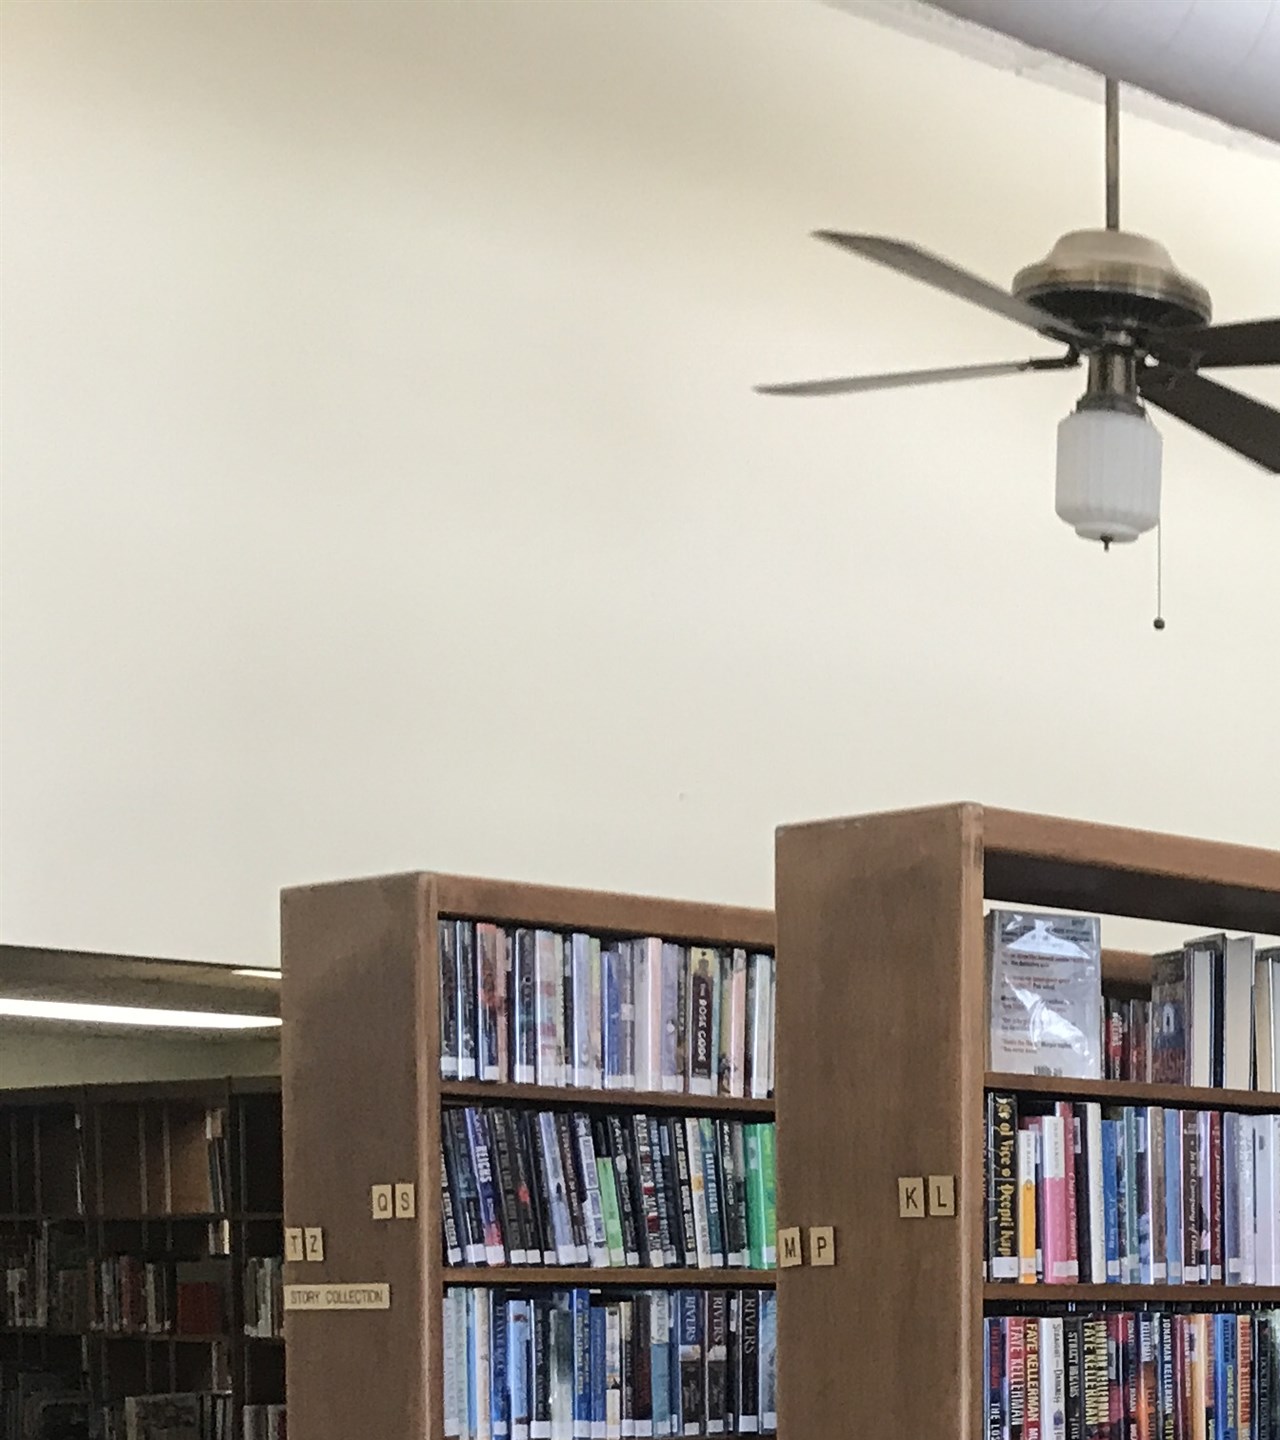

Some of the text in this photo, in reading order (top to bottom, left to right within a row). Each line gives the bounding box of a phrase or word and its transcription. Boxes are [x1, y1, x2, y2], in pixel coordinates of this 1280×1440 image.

[697, 999, 707, 1027] ROSE
[697, 1031, 707, 1061] CODE
[477, 1145, 492, 1183] REICHS
[1000, 1140, 1013, 1165] Vice
[706, 1153, 718, 1214] KATHY REICHS
[906, 1185, 947, 1209] K L
[1189, 1177, 1198, 1221] Company
[378, 1192, 411, 1211] Q S
[290, 1234, 317, 1254] T Z
[785, 1236, 827, 1258] M P
[1190, 1235, 1198, 1264] Others
[290, 1289, 384, 1305] STORY COLLECTION
[684, 1296, 697, 1341] RIVERS
[712, 1297, 724, 1342] RIVERS
[744, 1298, 756, 1354] RIVERS
[1027, 1324, 1037, 1350] FAYE
[1068, 1332, 1077, 1363] STREET
[1142, 1322, 1151, 1361] KELLERMAN
[1011, 1326, 1023, 1425] FAYE KELLERMAN
[1084, 1322, 1097, 1425] FAYE KELLERMAN
[1096, 1321, 1109, 1422] JONATHAN KELLERMAN
[1163, 1319, 1172, 1414] JONATHAN KELLERMAN
[1028, 1354, 1038, 1421] KELLERMAN
[990, 1403, 999, 1420] THE
